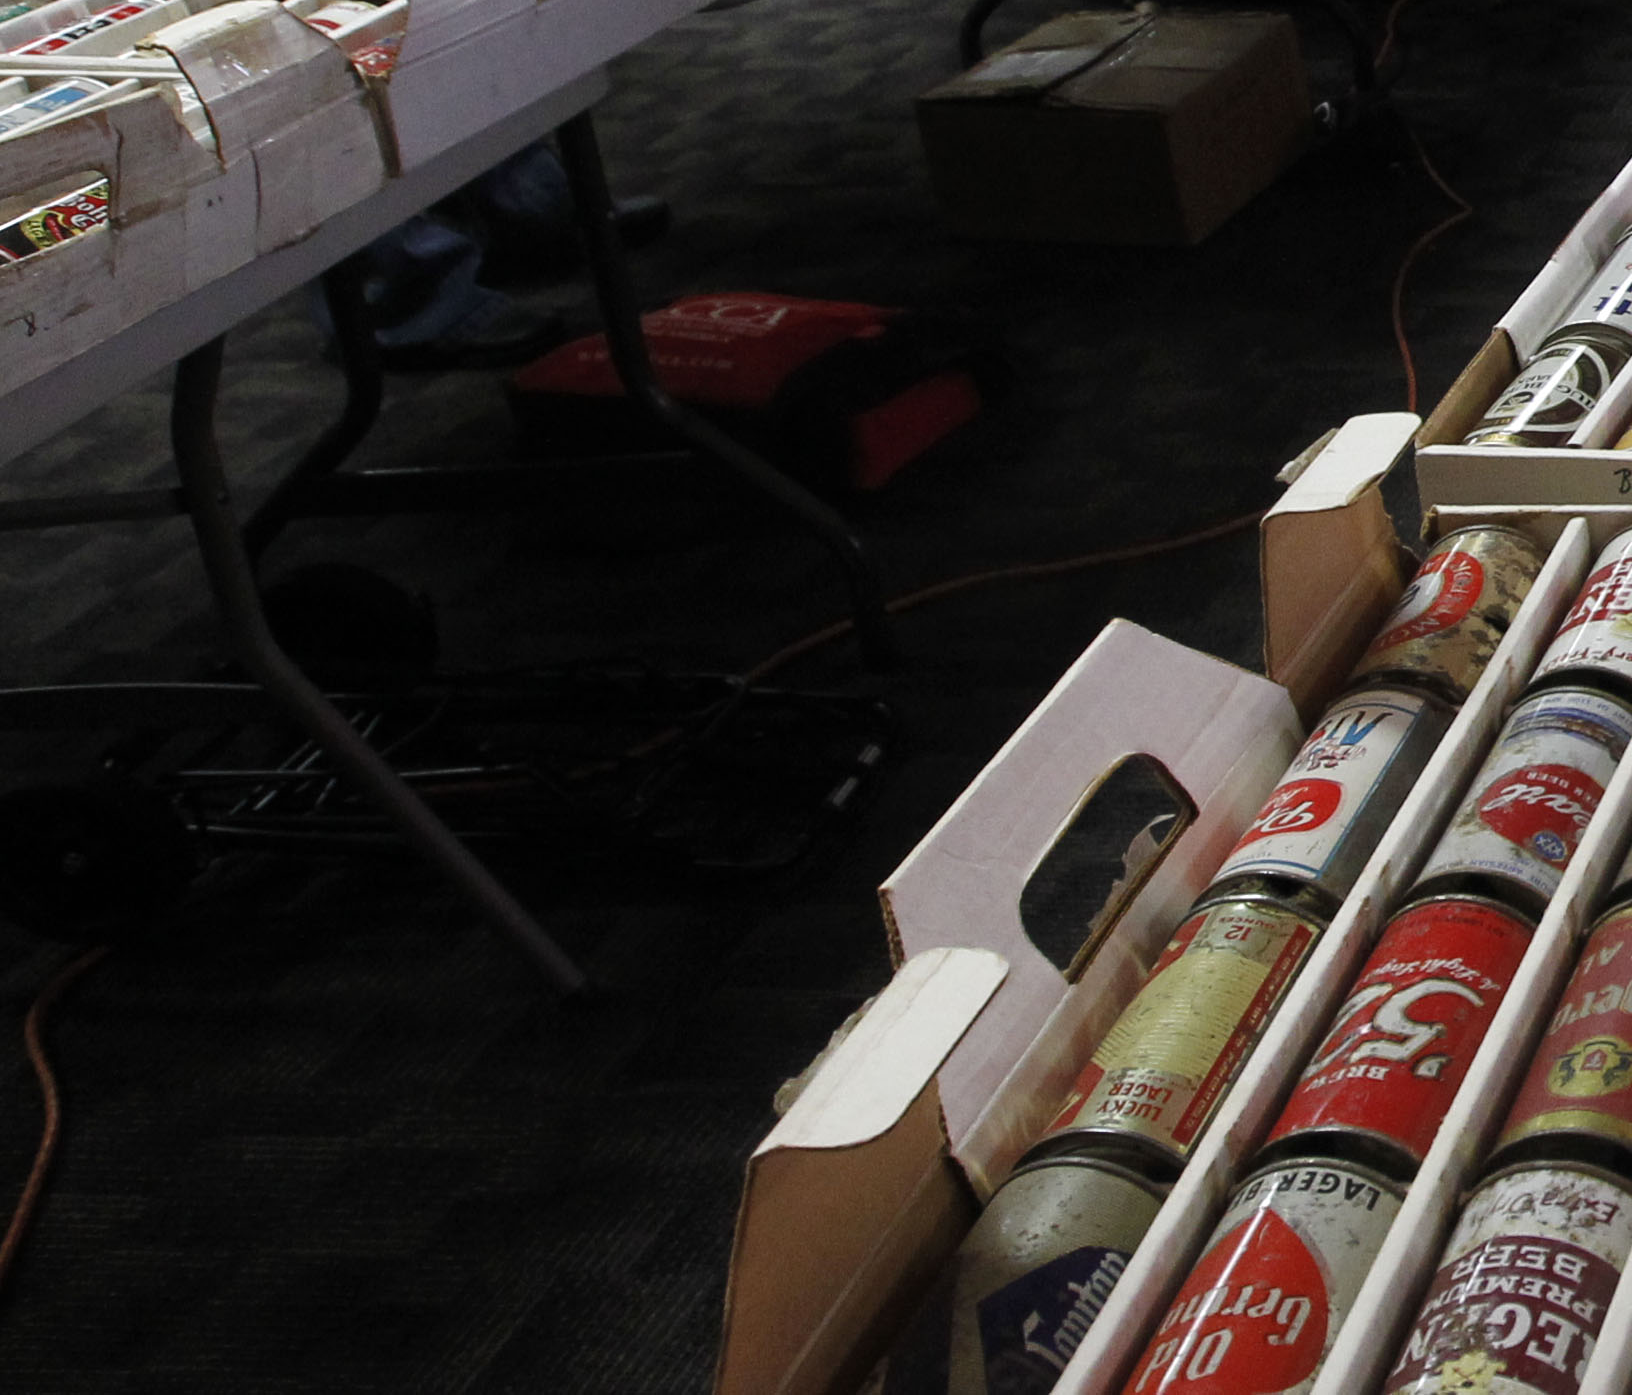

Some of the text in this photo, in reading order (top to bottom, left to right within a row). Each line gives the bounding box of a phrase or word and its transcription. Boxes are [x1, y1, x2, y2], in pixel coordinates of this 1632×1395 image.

[1223, 923, 1254, 942] 12
[1107, 1080, 1174, 1106] LAGER
[1095, 1098, 1163, 1121] LUCKY
[1276, 1170, 1381, 1212] LAGER
